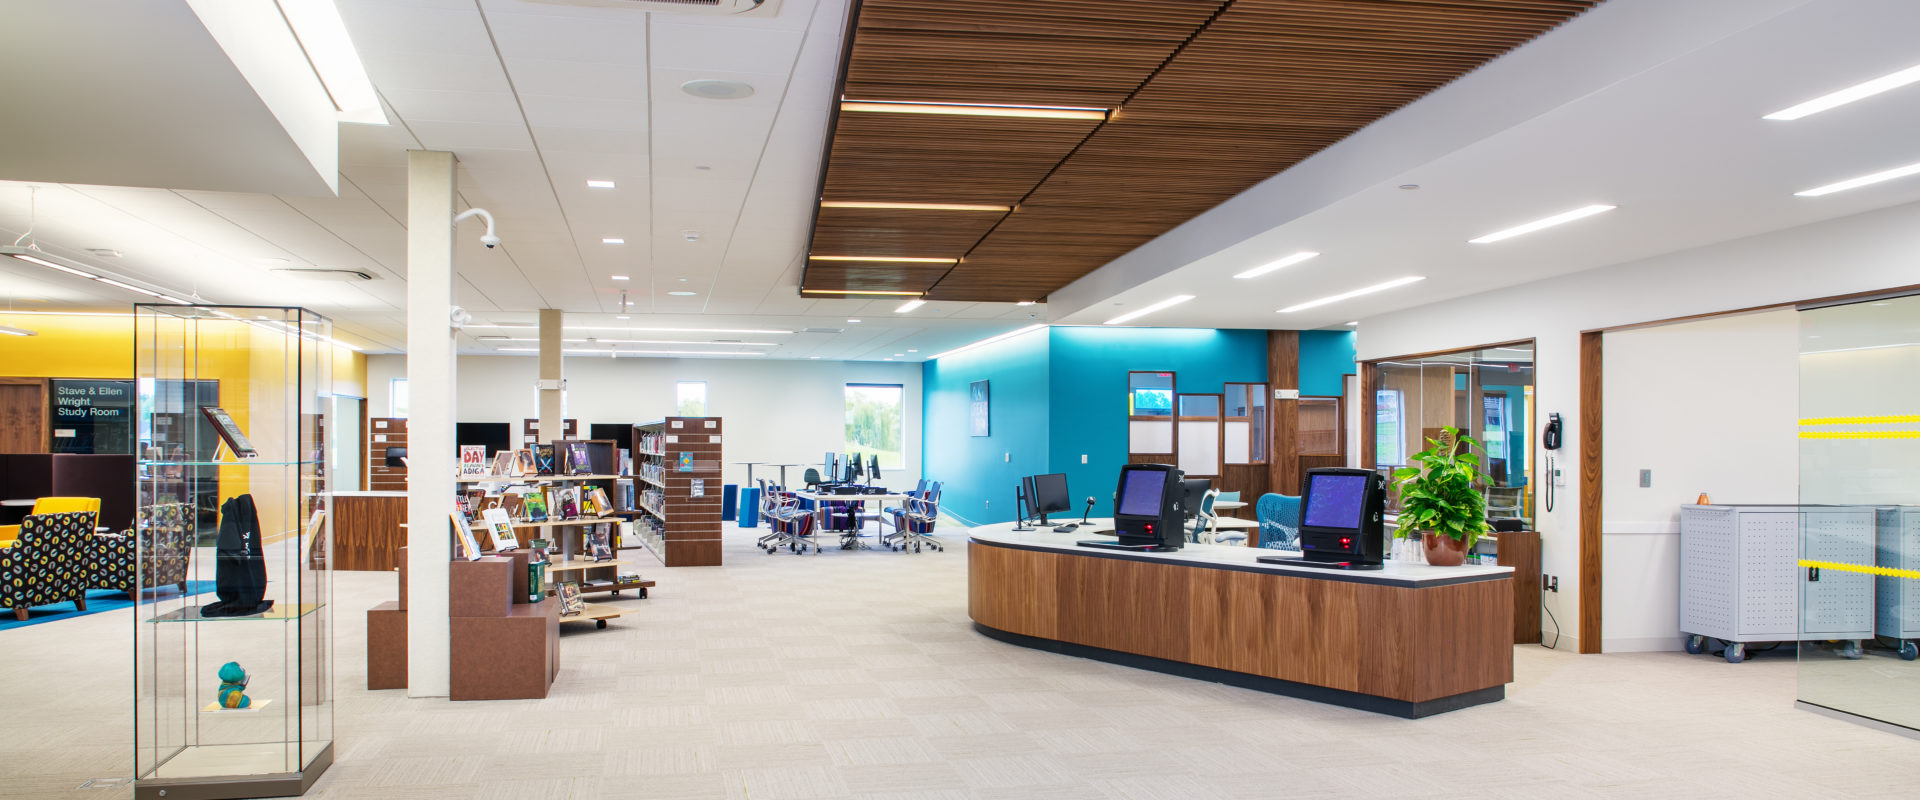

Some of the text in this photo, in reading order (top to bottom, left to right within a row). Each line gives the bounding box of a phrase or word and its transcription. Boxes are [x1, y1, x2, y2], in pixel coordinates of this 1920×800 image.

[88, 386, 96, 395] &
[98, 387, 123, 395] Ellen
[58, 397, 91, 407] Wright
[58, 407, 119, 418] Study Room
[464, 450, 485, 463] DAY
